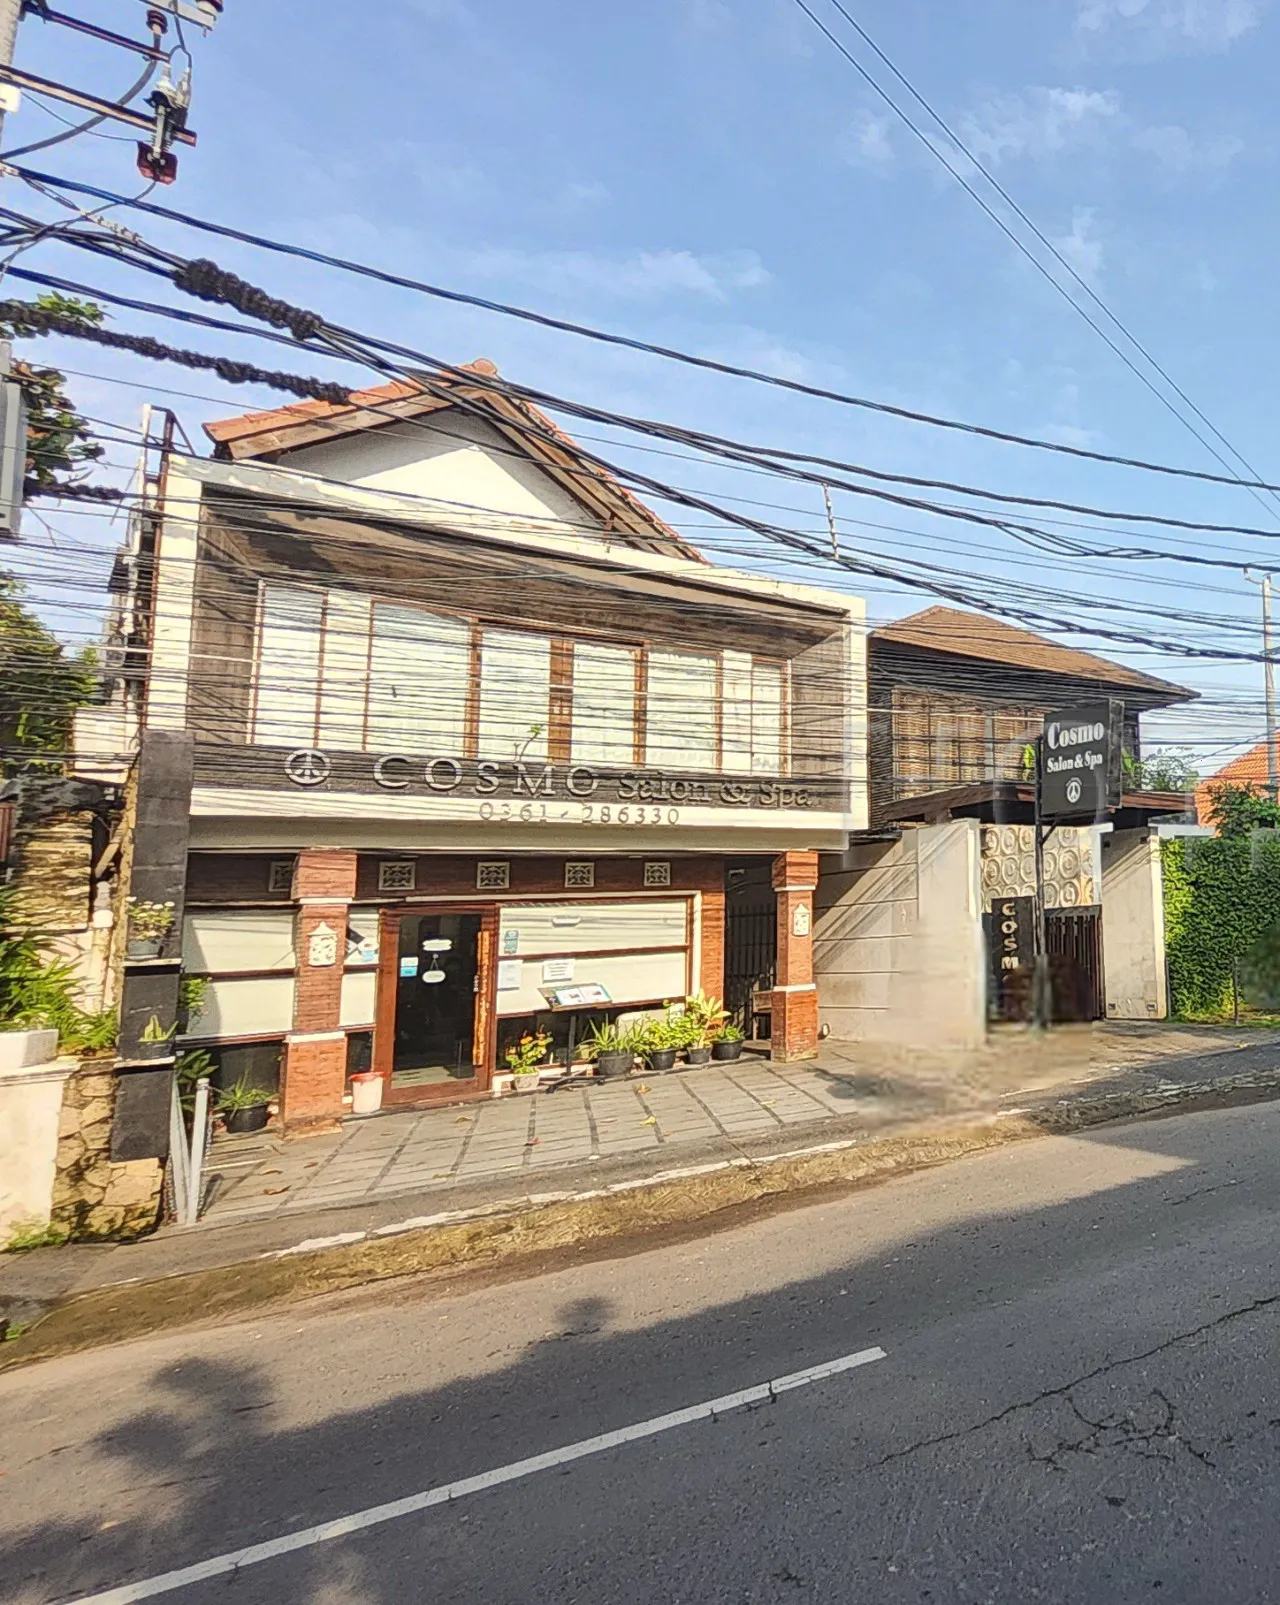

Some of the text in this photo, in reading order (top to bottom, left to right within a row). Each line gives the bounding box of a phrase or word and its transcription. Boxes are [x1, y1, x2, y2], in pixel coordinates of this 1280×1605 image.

[1047, 722, 1104, 749] Cosmo
[1047, 755, 1074, 773] Salon
[1084, 750, 1103, 770] Spa
[373, 754, 599, 797] COSMO
[617, 773, 712, 803] Salon
[759, 780, 811, 810] Spa
[478, 802, 547, 823] 0361
[580, 803, 680, 825] 286330
[1001, 902, 1020, 982] COSM
